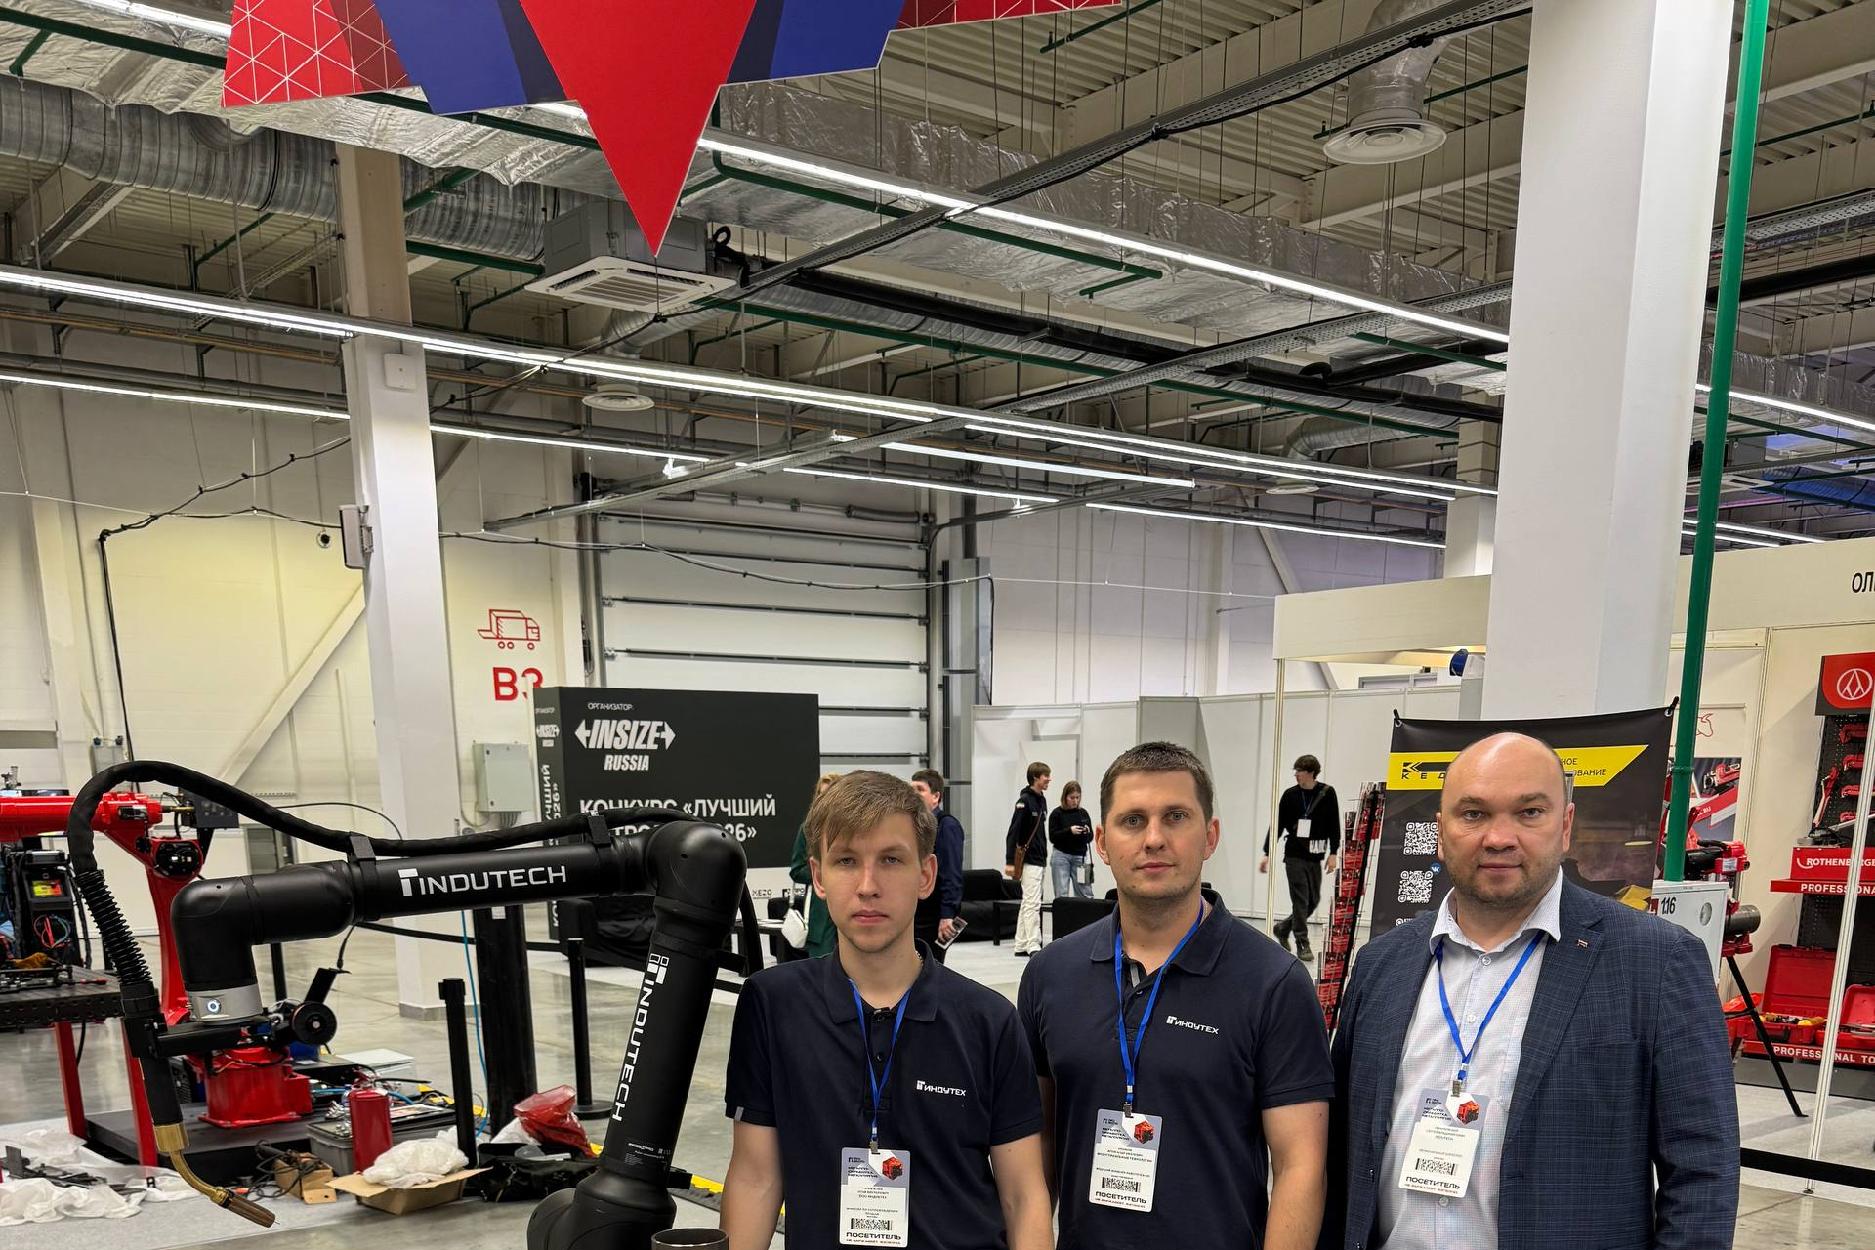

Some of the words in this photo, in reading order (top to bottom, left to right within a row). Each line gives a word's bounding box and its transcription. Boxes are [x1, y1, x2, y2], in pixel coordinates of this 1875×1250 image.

[1852, 571, 1875, 593] ОЛ
[588, 719, 663, 750] INSIZE
[603, 754, 650, 771] RUSSIA
[1401, 772, 1446, 780] КЕД
[683, 794, 776, 816] «ЛУЧШИЙ
[419, 866, 567, 896] INDUTECH
[611, 978, 655, 1122] INDUTECH
[1773, 1046, 1855, 1062] PROFESSNAL
[924, 1084, 967, 1096] ИНДУТЕХ
[1405, 1176, 1461, 1190] ПОСЕТИТЕЛЬ
[1095, 1191, 1147, 1204] ПОСЕТИТЕЛЬ
[846, 1231, 901, 1240] ПОСЕТИТЕЛЬ
